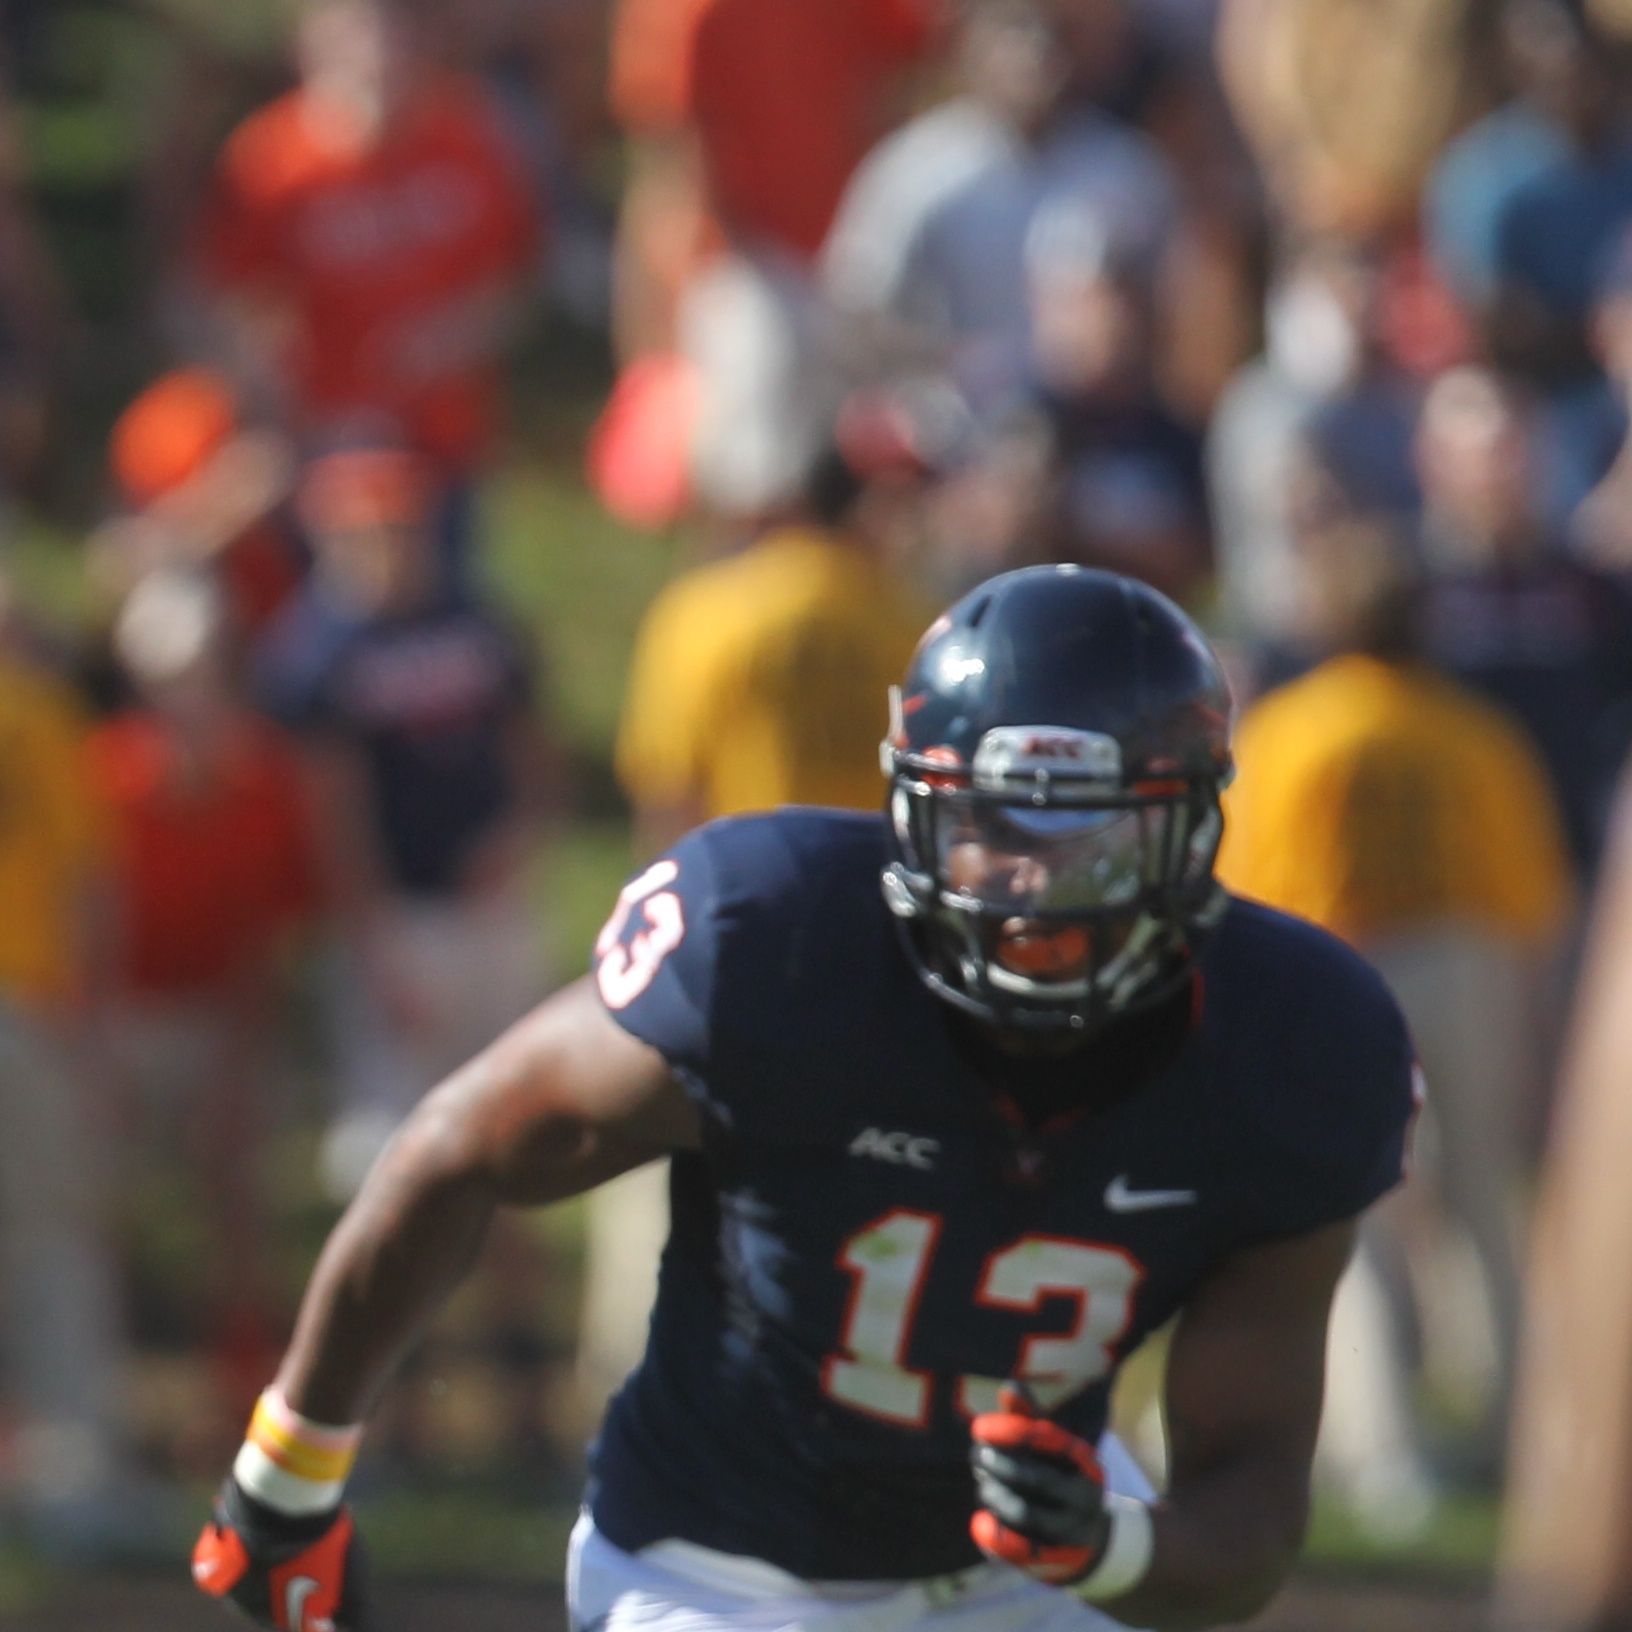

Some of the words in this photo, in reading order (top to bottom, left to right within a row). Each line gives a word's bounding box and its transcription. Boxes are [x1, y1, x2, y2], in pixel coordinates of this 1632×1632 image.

[594, 860, 685, 1010] 13
[848, 1126, 941, 1170] ACC
[819, 1206, 1147, 1430] 13
